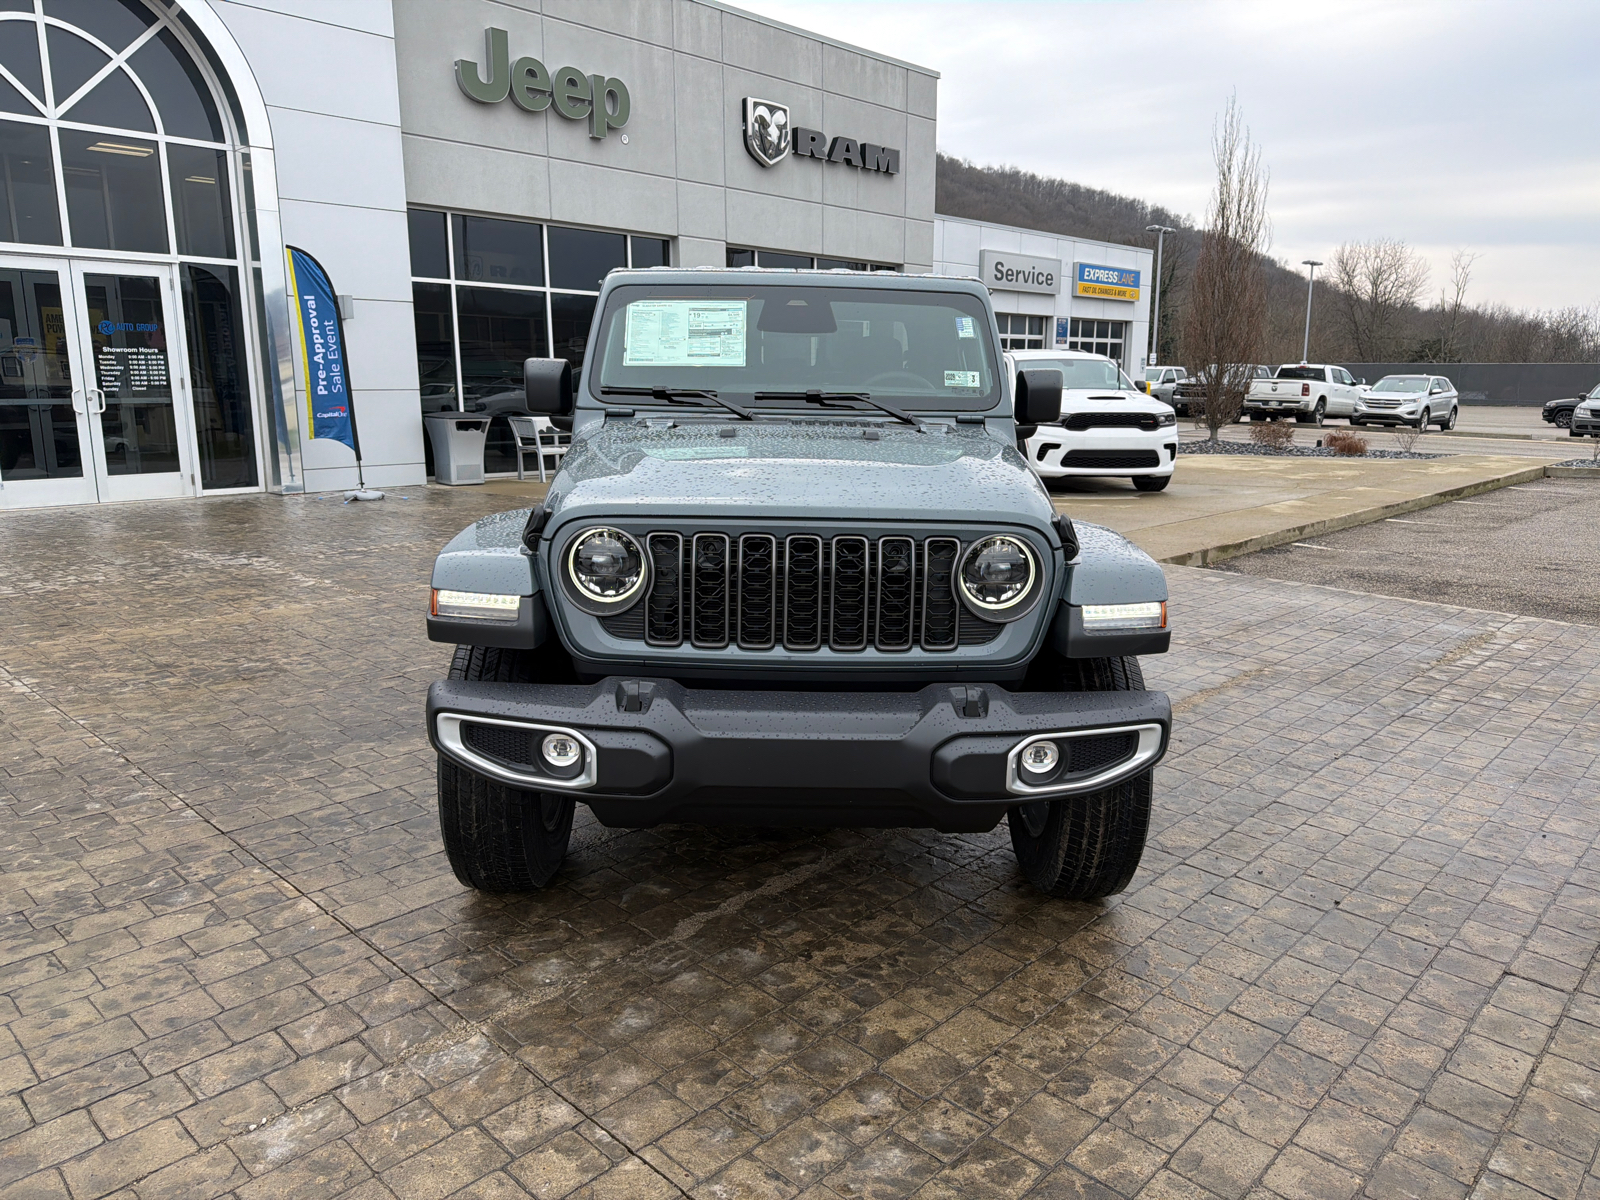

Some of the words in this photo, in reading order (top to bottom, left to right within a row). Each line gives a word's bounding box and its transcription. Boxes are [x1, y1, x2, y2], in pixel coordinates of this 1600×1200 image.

[455, 26, 631, 140] Jeep
[791, 126, 900, 175] RAM
[994, 261, 1054, 287] Service
[1082, 286, 1092, 294] FAST
[1098, 287, 1114, 296] CHANGES
[116, 323, 134, 331] AUTO
[136, 323, 158, 332] GROUP
[323, 319, 339, 360] Event
[303, 295, 329, 395] Pre-Approval
[329, 361, 343, 393] Sale
[972, 374, 976, 383] 3
